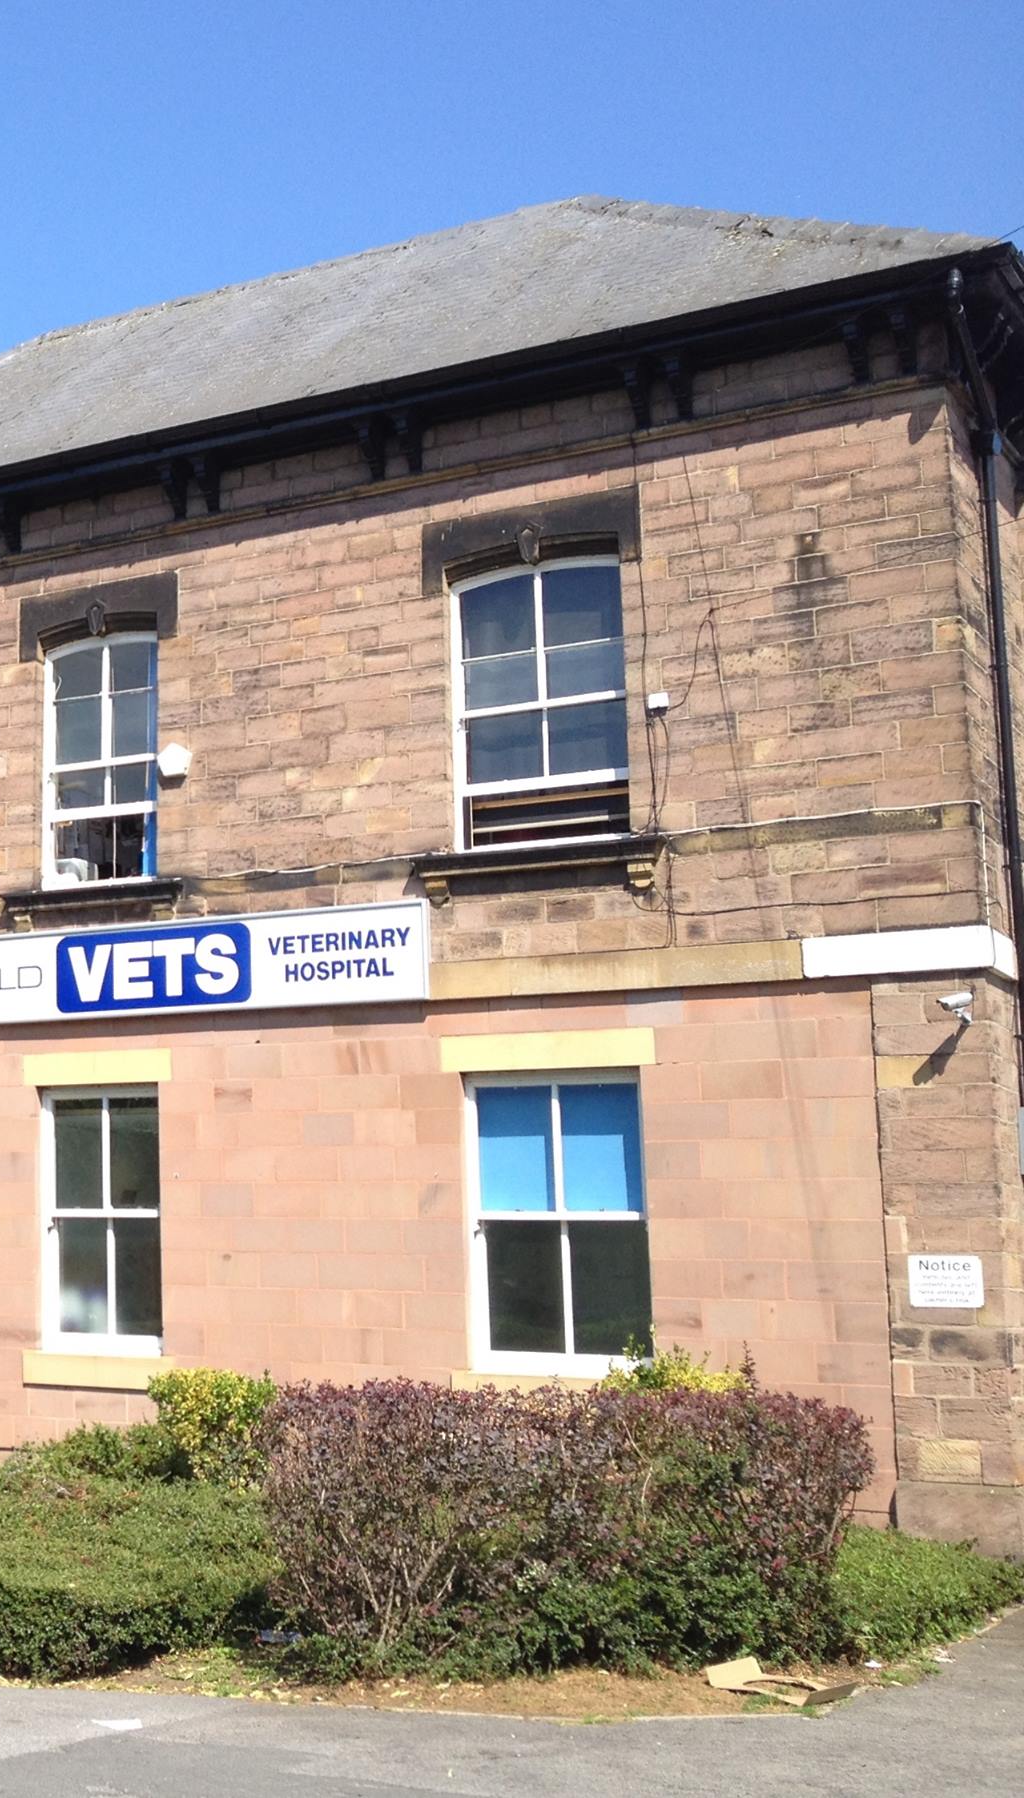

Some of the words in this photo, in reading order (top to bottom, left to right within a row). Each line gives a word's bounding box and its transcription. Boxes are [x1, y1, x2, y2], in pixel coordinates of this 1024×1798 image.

[268, 927, 410, 956] VETERINARY
[67, 933, 240, 1003] VETS
[285, 957, 394, 982] HOSPITAL
[918, 1260, 972, 1272] Notice
